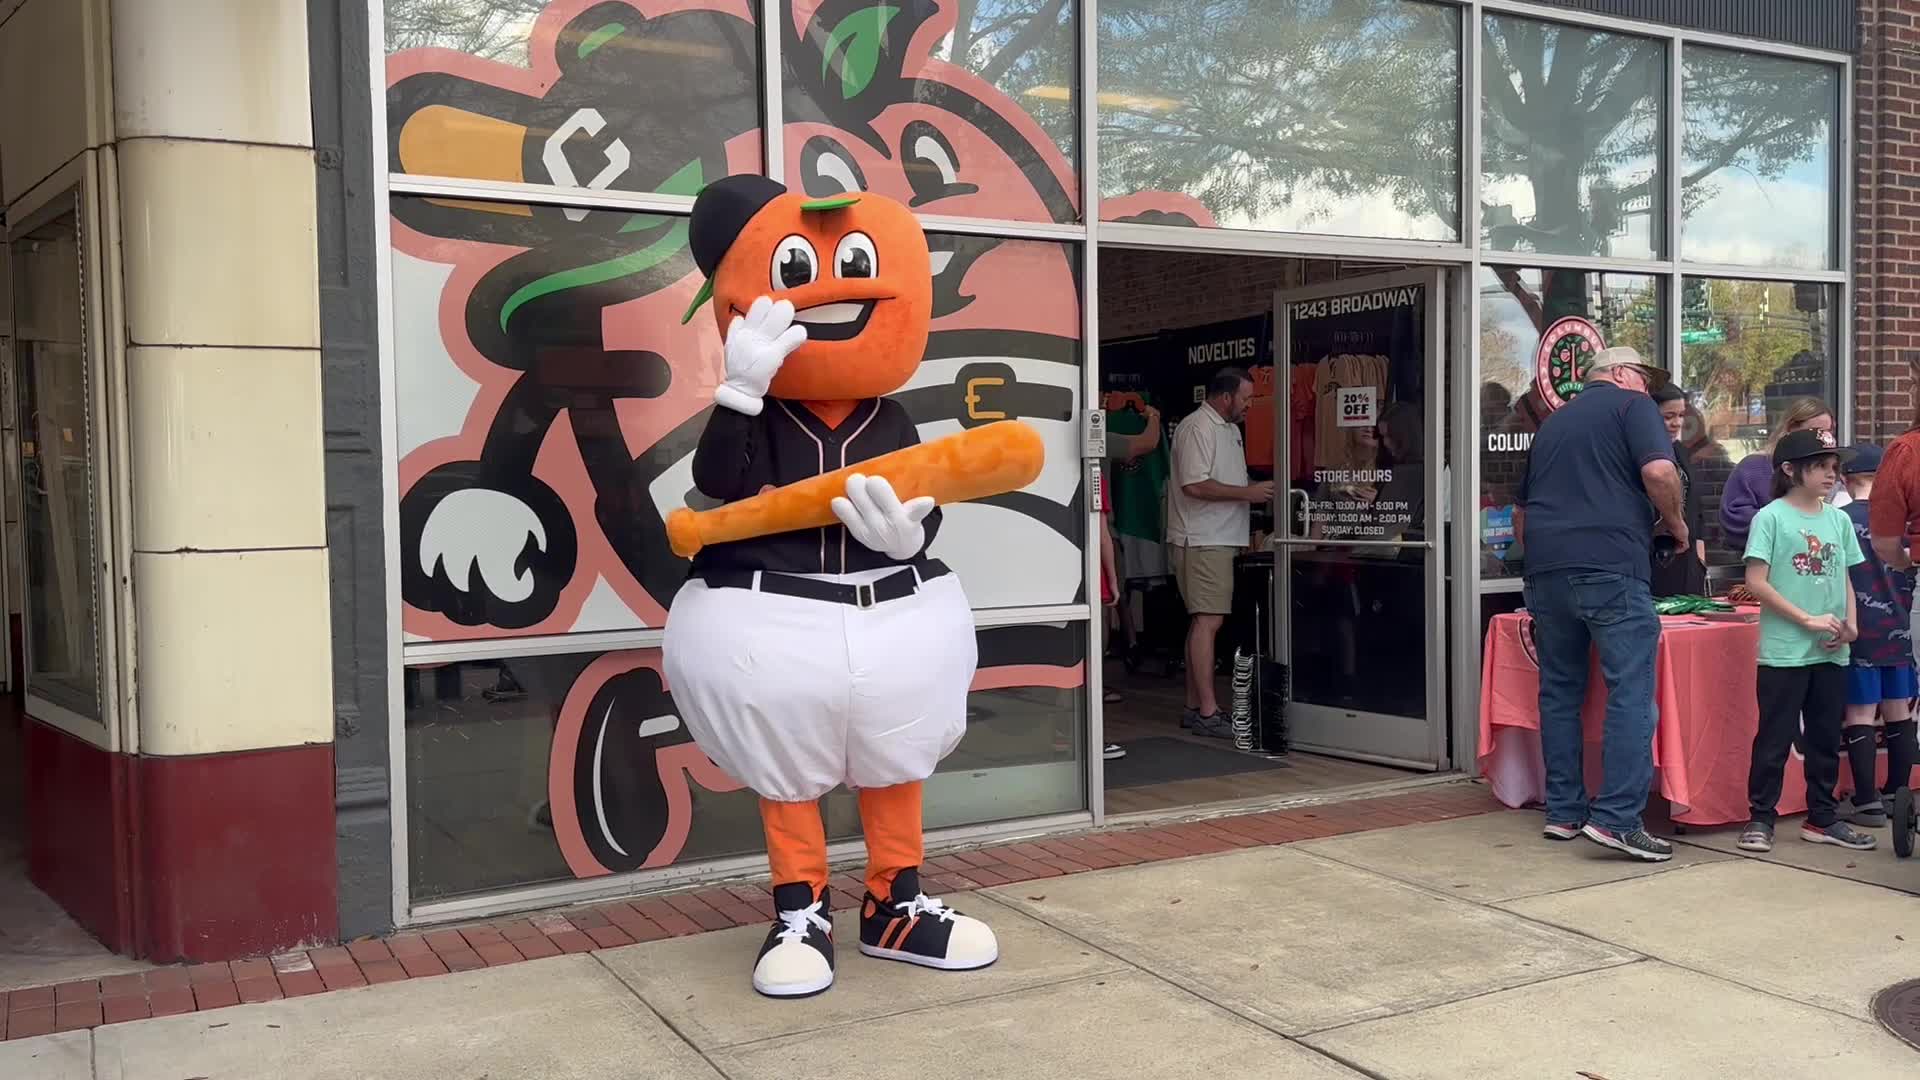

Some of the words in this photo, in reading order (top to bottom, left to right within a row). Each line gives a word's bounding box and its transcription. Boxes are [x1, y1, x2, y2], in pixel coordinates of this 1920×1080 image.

[1293, 300, 1327, 320] 1243
[1331, 288, 1418, 316] BROADWAY
[1188, 337, 1255, 365] NOVELTIES
[1343, 393, 1369, 403] 20%
[1343, 404, 1369, 416] OFF
[1314, 470, 1350, 482] STORE
[1352, 469, 1392, 482] HOURS
[1335, 501, 1355, 510] 10:00
[1356, 502, 1368, 510] AM
[1375, 501, 1394, 510] 5:00
[1395, 501, 1408, 510] PM
[1338, 513, 1358, 522] 10:00
[1359, 514, 1372, 522] AM
[1379, 514, 1397, 523] 2:00
[1398, 514, 1411, 523] PM
[1321, 525, 1353, 535] SUNDAY:
[1354, 526, 1384, 535] CLOSED
